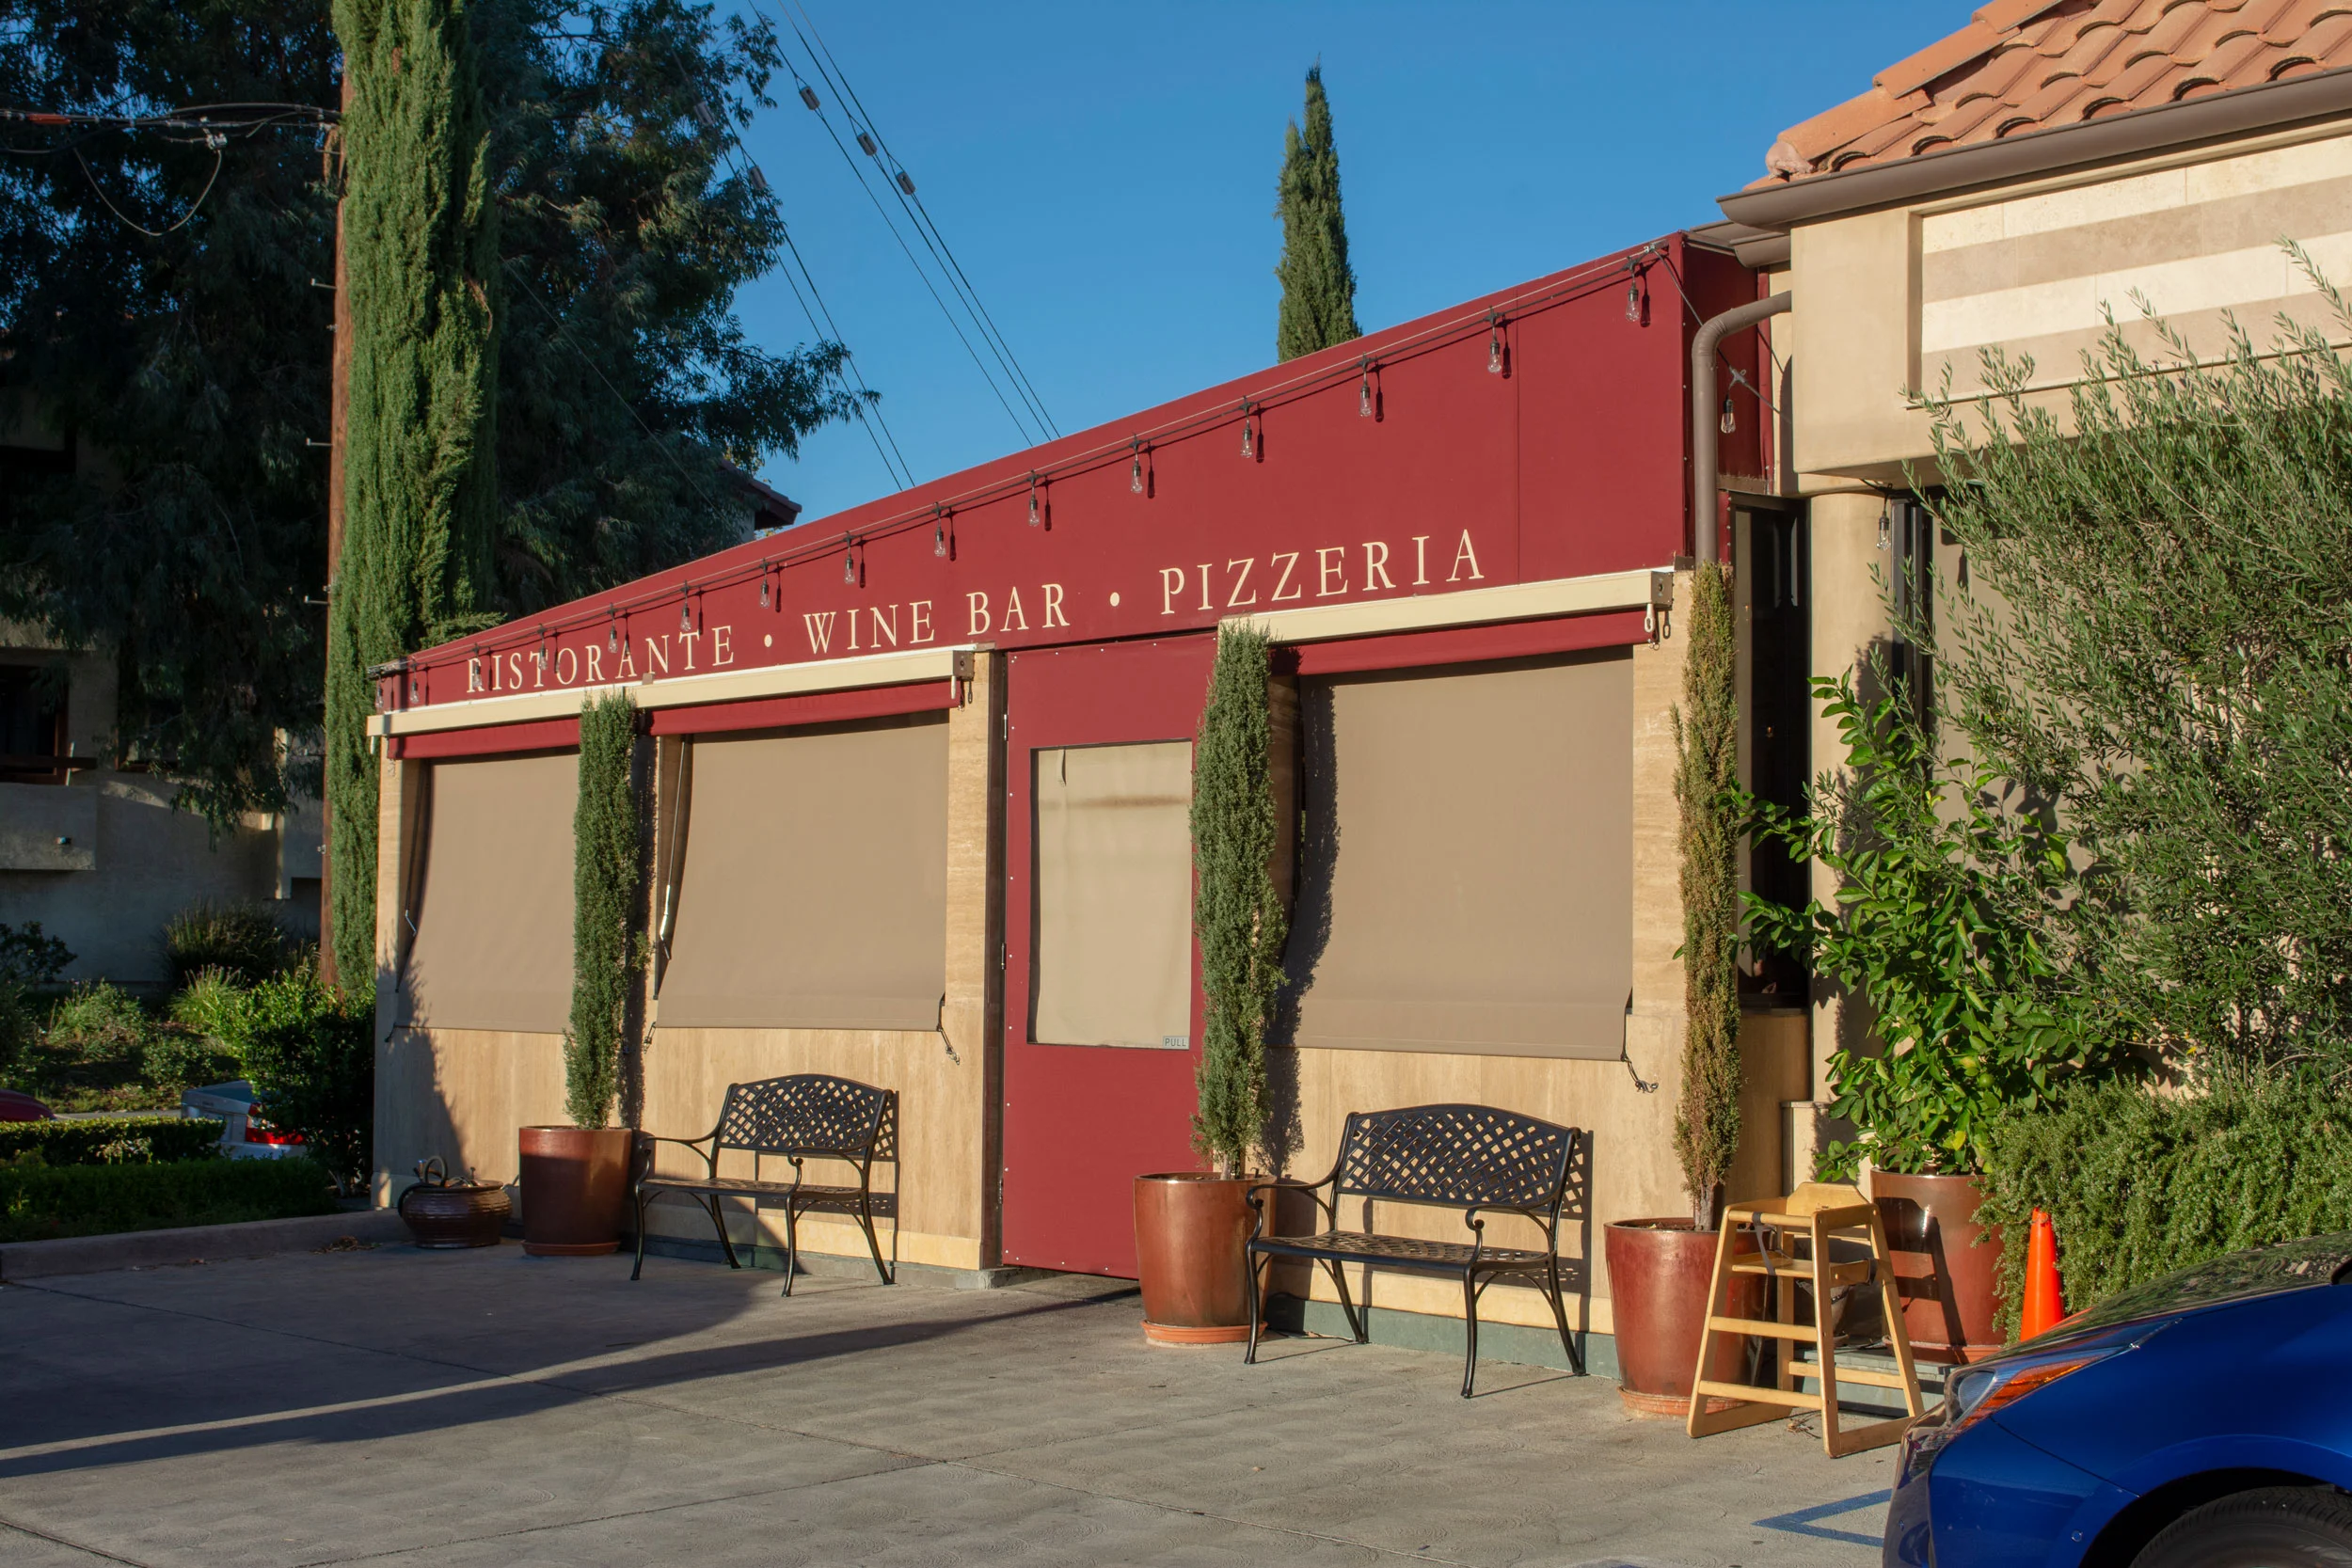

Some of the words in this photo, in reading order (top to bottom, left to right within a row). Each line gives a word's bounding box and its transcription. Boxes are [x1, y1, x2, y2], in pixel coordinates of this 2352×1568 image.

[467, 626, 734, 693] RISTORANTE
[803, 599, 935, 655] WINE
[966, 583, 1071, 636] BAR
[1159, 529, 1485, 615] PIZZERIA
[1165, 1037, 1186, 1047] PULL
